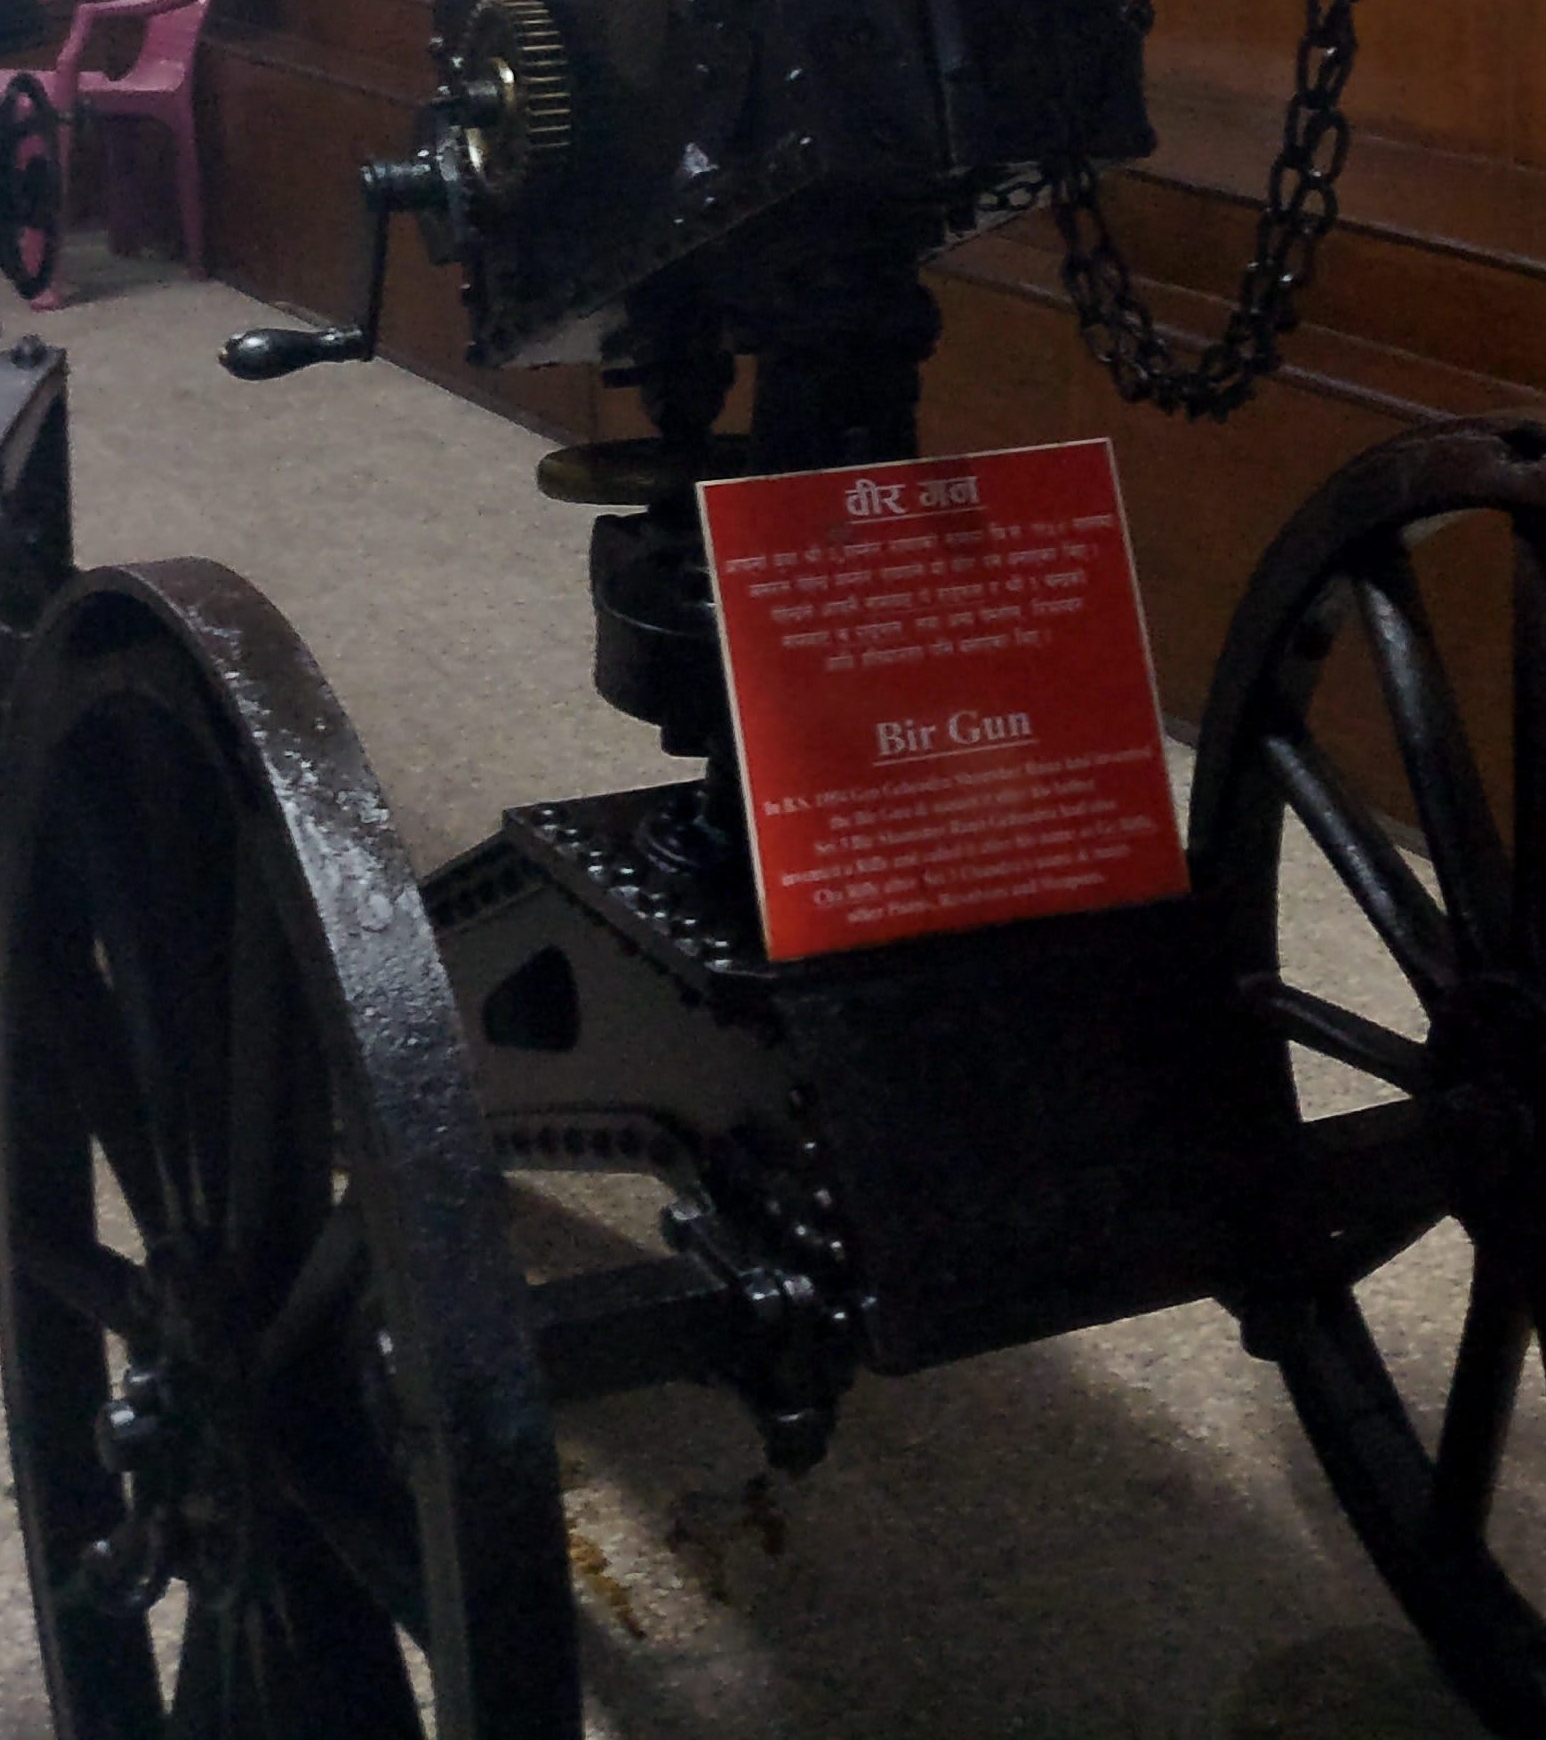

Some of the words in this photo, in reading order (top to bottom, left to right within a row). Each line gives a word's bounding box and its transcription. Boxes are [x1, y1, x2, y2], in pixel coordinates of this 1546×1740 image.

[917, 476, 979, 507] गन
[876, 719, 936, 756] Bir
[948, 711, 1032, 745] Gun
